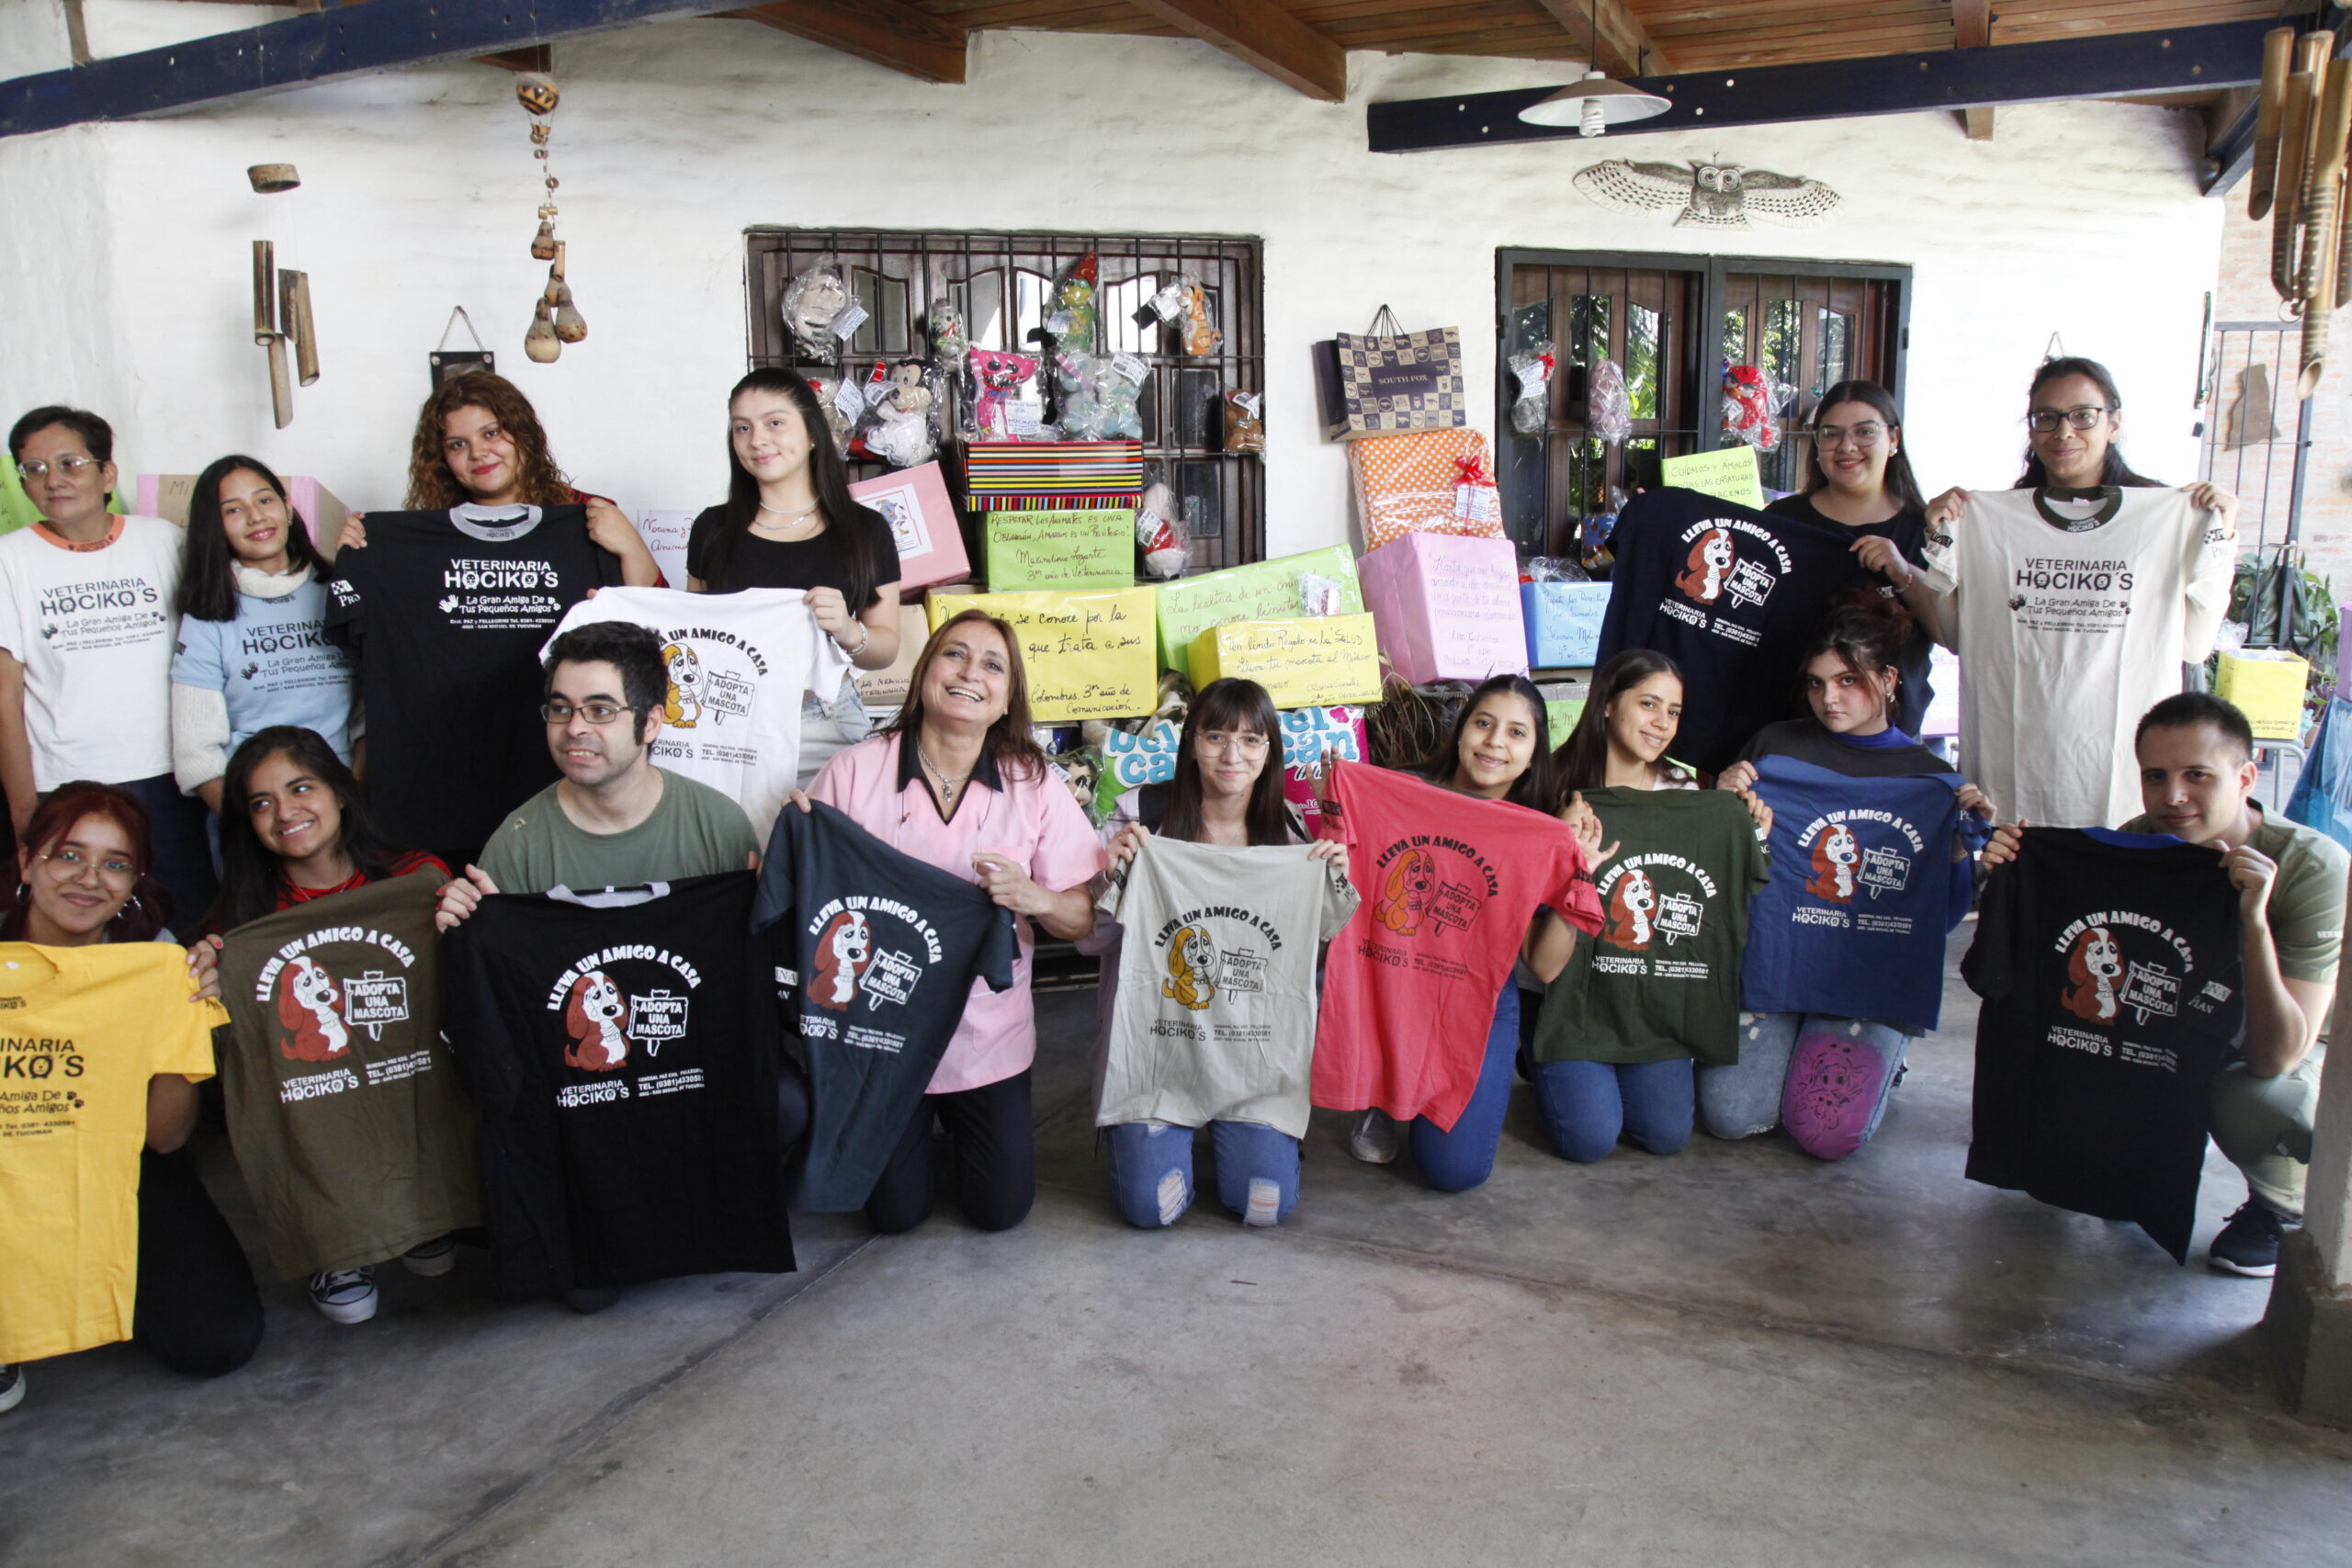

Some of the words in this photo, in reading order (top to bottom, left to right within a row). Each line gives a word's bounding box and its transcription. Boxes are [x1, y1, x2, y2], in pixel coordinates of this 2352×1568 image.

[1378, 376, 1408, 385] SOUTH
[1411, 374, 1428, 383] FOX
[1681, 519, 1713, 544] LLEVA
[1714, 518, 1733, 528] UN
[1732, 520, 1770, 541] AMIGO
[1768, 538, 1780, 548] A
[1775, 546, 1792, 574] CASA
[450, 558, 551, 571] VETERINARIA
[2025, 558, 2127, 571] VETERINARIA
[1739, 567, 1770, 589] ADOPTA
[1742, 578, 1758, 591] UNA
[43, 577, 146, 598] VETERINARIA
[1729, 581, 1764, 604] MASCOTA
[466, 595, 477, 604] La
[480, 595, 501, 604] Gran
[503, 595, 529, 604] Amiga
[532, 595, 545, 604] De
[2035, 597, 2046, 605] La
[2049, 597, 2070, 607] Gran
[2072, 598, 2100, 609] Amiga
[2103, 599, 2116, 608] De
[459, 605, 475, 614] Tus
[478, 604, 518, 614] Pequeños
[520, 604, 551, 614] Amigos
[2027, 605, 2043, 615] Tus
[2045, 606, 2087, 617] Pequeños
[2089, 608, 2122, 618] Amigos
[125, 620, 157, 630] Amigos
[1086, 609, 1102, 635] por
[1110, 604, 1127, 623] la
[243, 631, 327, 656] HOCIK
[1028, 641, 1050, 663] que
[1058, 633, 1097, 655] trata
[668, 629, 688, 641] UN
[691, 628, 736, 645] AMIGO
[737, 640, 747, 651] A
[747, 648, 768, 677] CASA
[260, 669, 279, 678] Tus
[714, 678, 749, 695] ADOPTA
[719, 690, 737, 702] UNA
[708, 696, 746, 714] MASCOTA
[1121, 753, 1175, 784] ca
[1797, 818, 1828, 848] LLEVA
[1826, 811, 1847, 824] UN
[1848, 809, 1893, 823] AMIGO
[1892, 818, 1903, 829] A
[1902, 823, 1925, 853] CASA
[1375, 840, 1409, 869] LLEVA
[1411, 836, 1430, 847] UN
[1432, 836, 1476, 858] AMIGO
[1474, 857, 1486, 867] A
[1482, 866, 1498, 897] CASA
[1871, 854, 1905, 871] ADOPTA
[1596, 864, 1625, 896] LLEVA
[1623, 855, 1643, 869] UN
[1644, 853, 1686, 870] AMIGO
[1686, 863, 1696, 874] A
[1694, 868, 1718, 898] CASA
[1876, 866, 1894, 877] UNA
[1864, 873, 1902, 887] MASCOTA
[1666, 901, 1698, 916] ADOPTA
[1671, 912, 1688, 923] UNA
[808, 898, 844, 936] LLEVA
[845, 897, 868, 909] UN
[869, 897, 918, 923] AMIGO
[914, 919, 928, 932] A
[923, 929, 942, 964] CASA
[1155, 919, 1182, 948] LLEVA
[1182, 909, 1202, 923] UN
[1204, 907, 1250, 921] AMIGO
[1250, 916, 1260, 927] A
[1260, 921, 1283, 952] CASA
[1660, 919, 1696, 933] MASCOTA
[2054, 919, 2087, 954] LLEVA
[2086, 912, 2109, 927] UN
[2110, 910, 2161, 933] AMIGO
[2161, 929, 2174, 942] A
[2173, 937, 2194, 974] CASA
[256, 957, 286, 1002] LLEVA
[278, 939, 306, 959] UN
[306, 927, 364, 948] AMIGO
[366, 930, 378, 944] A
[379, 933, 416, 968] CASA
[879, 958, 916, 982] ADOPTA
[1227, 957, 1262, 970] ADOPTA
[548, 969, 580, 1010] LLEVA
[576, 953, 601, 973] UN
[602, 945, 656, 964] AMIGO
[657, 950, 669, 964] A
[671, 955, 702, 989] CASA
[882, 972, 901, 986] UNA
[1232, 968, 1250, 978] UNA
[867, 976, 907, 1000] MASCOTA
[1222, 977, 1259, 990] MASCOTA
[2136, 970, 2177, 993] ADOPTA
[354, 983, 401, 997] ADOPTA
[2143, 985, 2162, 998] UNA
[365, 996, 389, 1008] UNA
[639, 1001, 683, 1014] ADOPTA
[2129, 991, 2174, 1013] MASCOTA
[354, 1007, 404, 1019] MASCOTA
[648, 1014, 670, 1024] UNA
[636, 1024, 683, 1035] MASCOTA
[0, 1037, 75, 1053] INARIA
[282, 1067, 352, 1089] VETERINARIA
[280, 1076, 359, 1104] HOCIKO'S
[560, 1080, 624, 1095] VETERINARIA
[638, 1082, 654, 1090] TEL.
[42, 1090, 62, 1101] De
[557, 1087, 630, 1108] HOCIKO'S
[23, 1103, 70, 1114] Amigos
